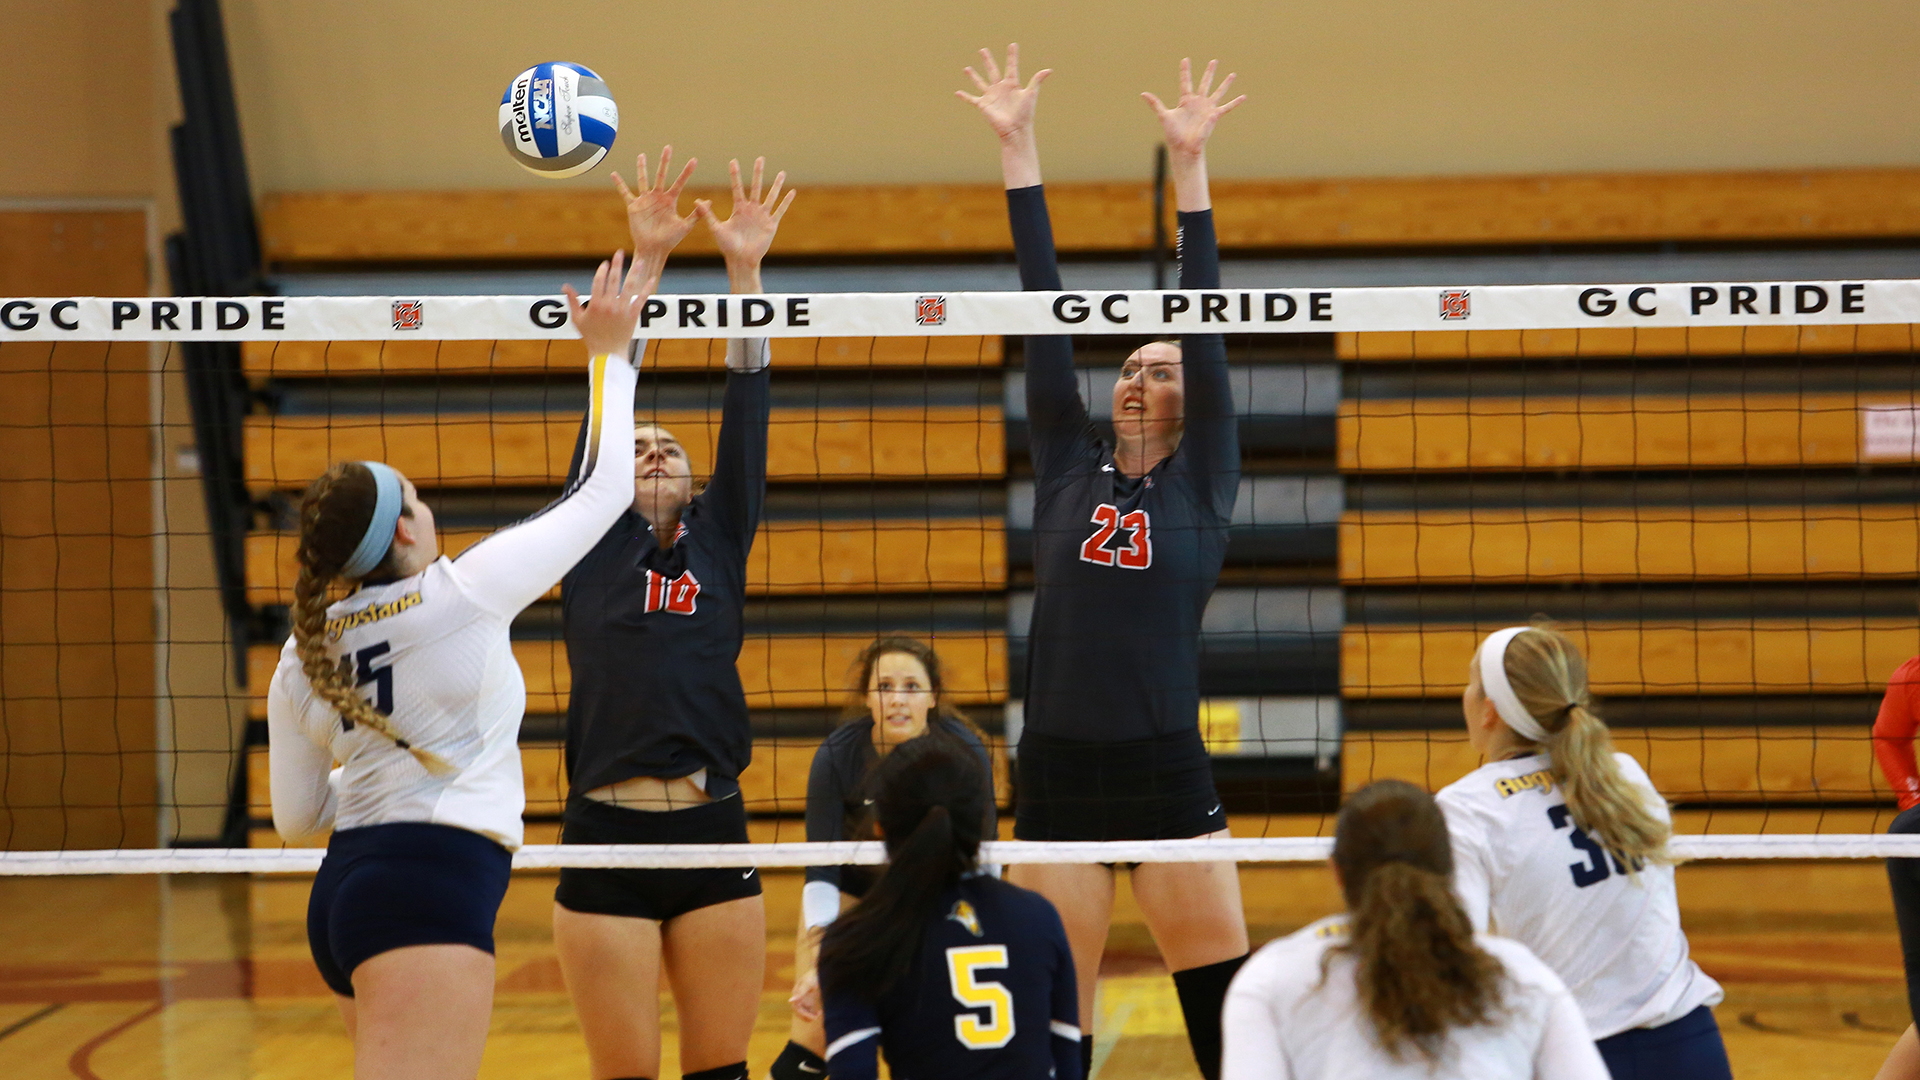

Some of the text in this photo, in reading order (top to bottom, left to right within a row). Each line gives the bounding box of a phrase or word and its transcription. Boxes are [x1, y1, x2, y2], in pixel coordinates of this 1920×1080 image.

[513, 79, 531, 142] molten
[533, 78, 554, 130] NCAA
[0, 301, 285, 331] GC PRIDE
[640, 298, 809, 328] PRIDE
[1052, 292, 1333, 323] GC PRIDE
[1578, 284, 1865, 317] GC PRIDE
[1079, 503, 1153, 570] 23
[644, 569, 701, 616] 10
[945, 944, 1016, 1050] 5
